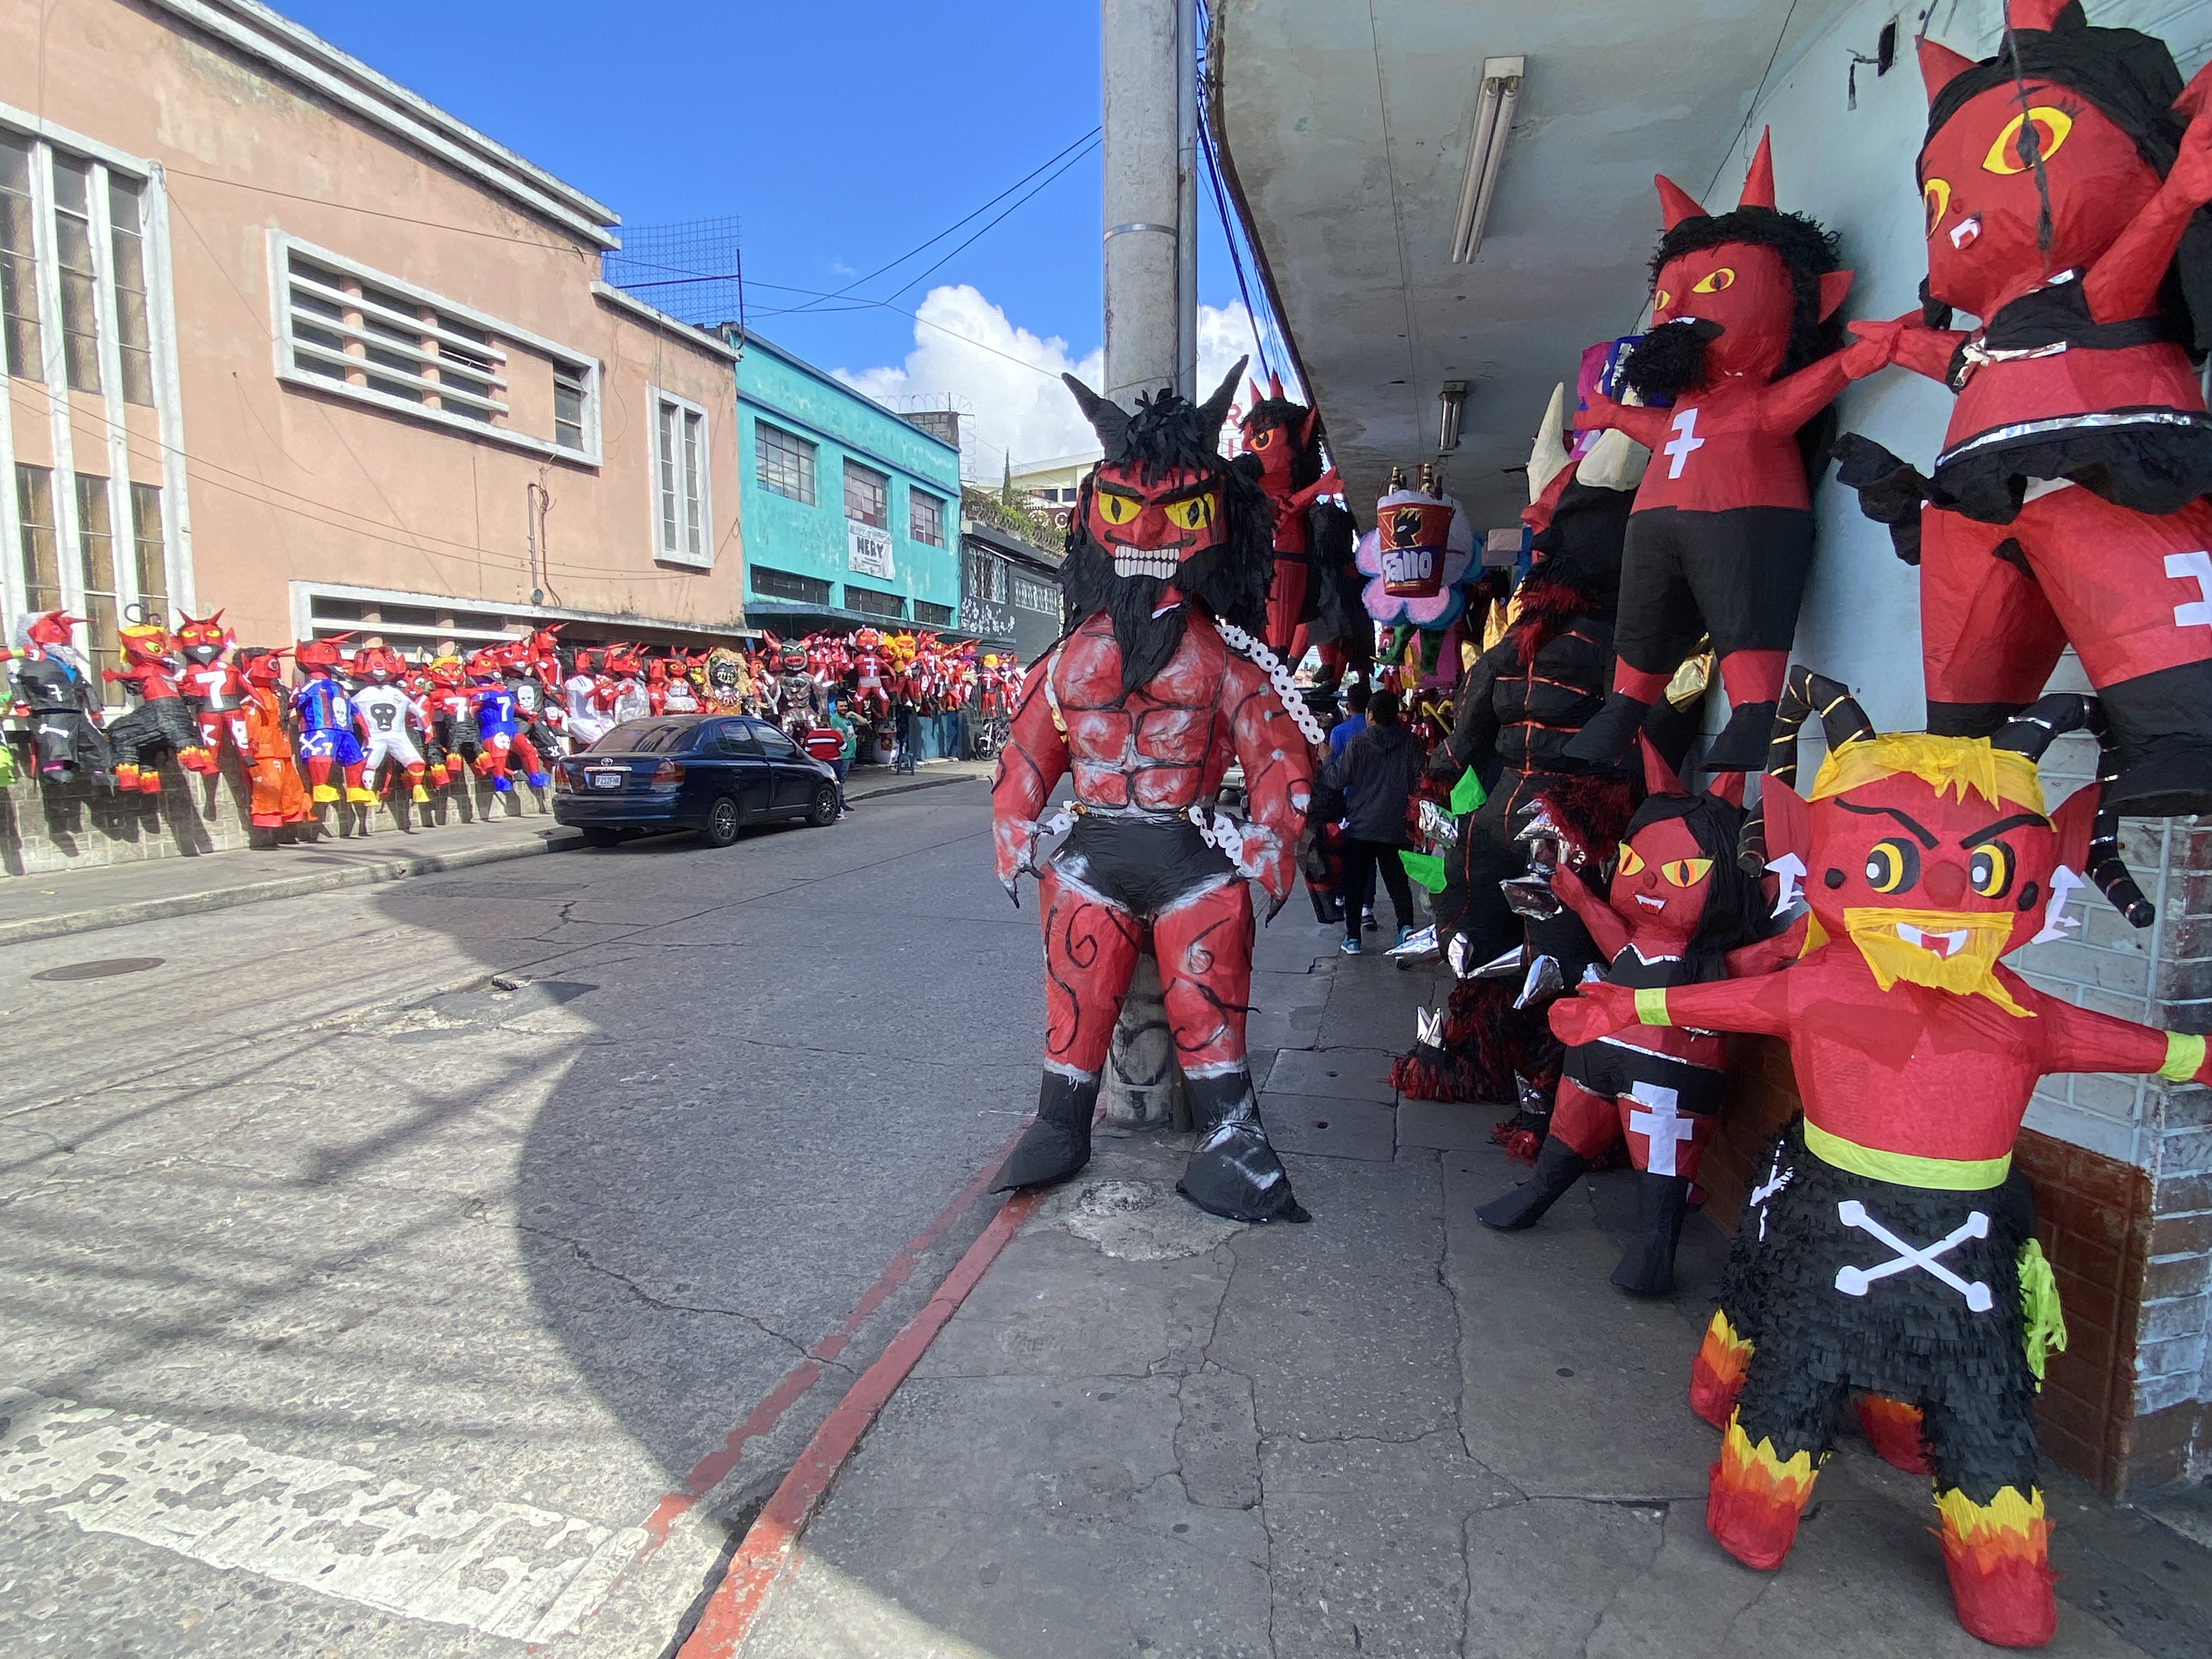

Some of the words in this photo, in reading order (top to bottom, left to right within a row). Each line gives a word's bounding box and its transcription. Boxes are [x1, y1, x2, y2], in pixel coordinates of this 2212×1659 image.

[1663, 408, 1705, 479] 7
[857, 536, 883, 558] NERY
[864, 658, 877, 678] 7
[47, 684, 63, 702] 7
[195, 670, 227, 708] 7
[983, 673, 992, 690] 7
[444, 697, 468, 722] 7
[496, 696, 511, 722] 7
[321, 742, 333, 756] 7
[1629, 1081, 1694, 1176] 7
